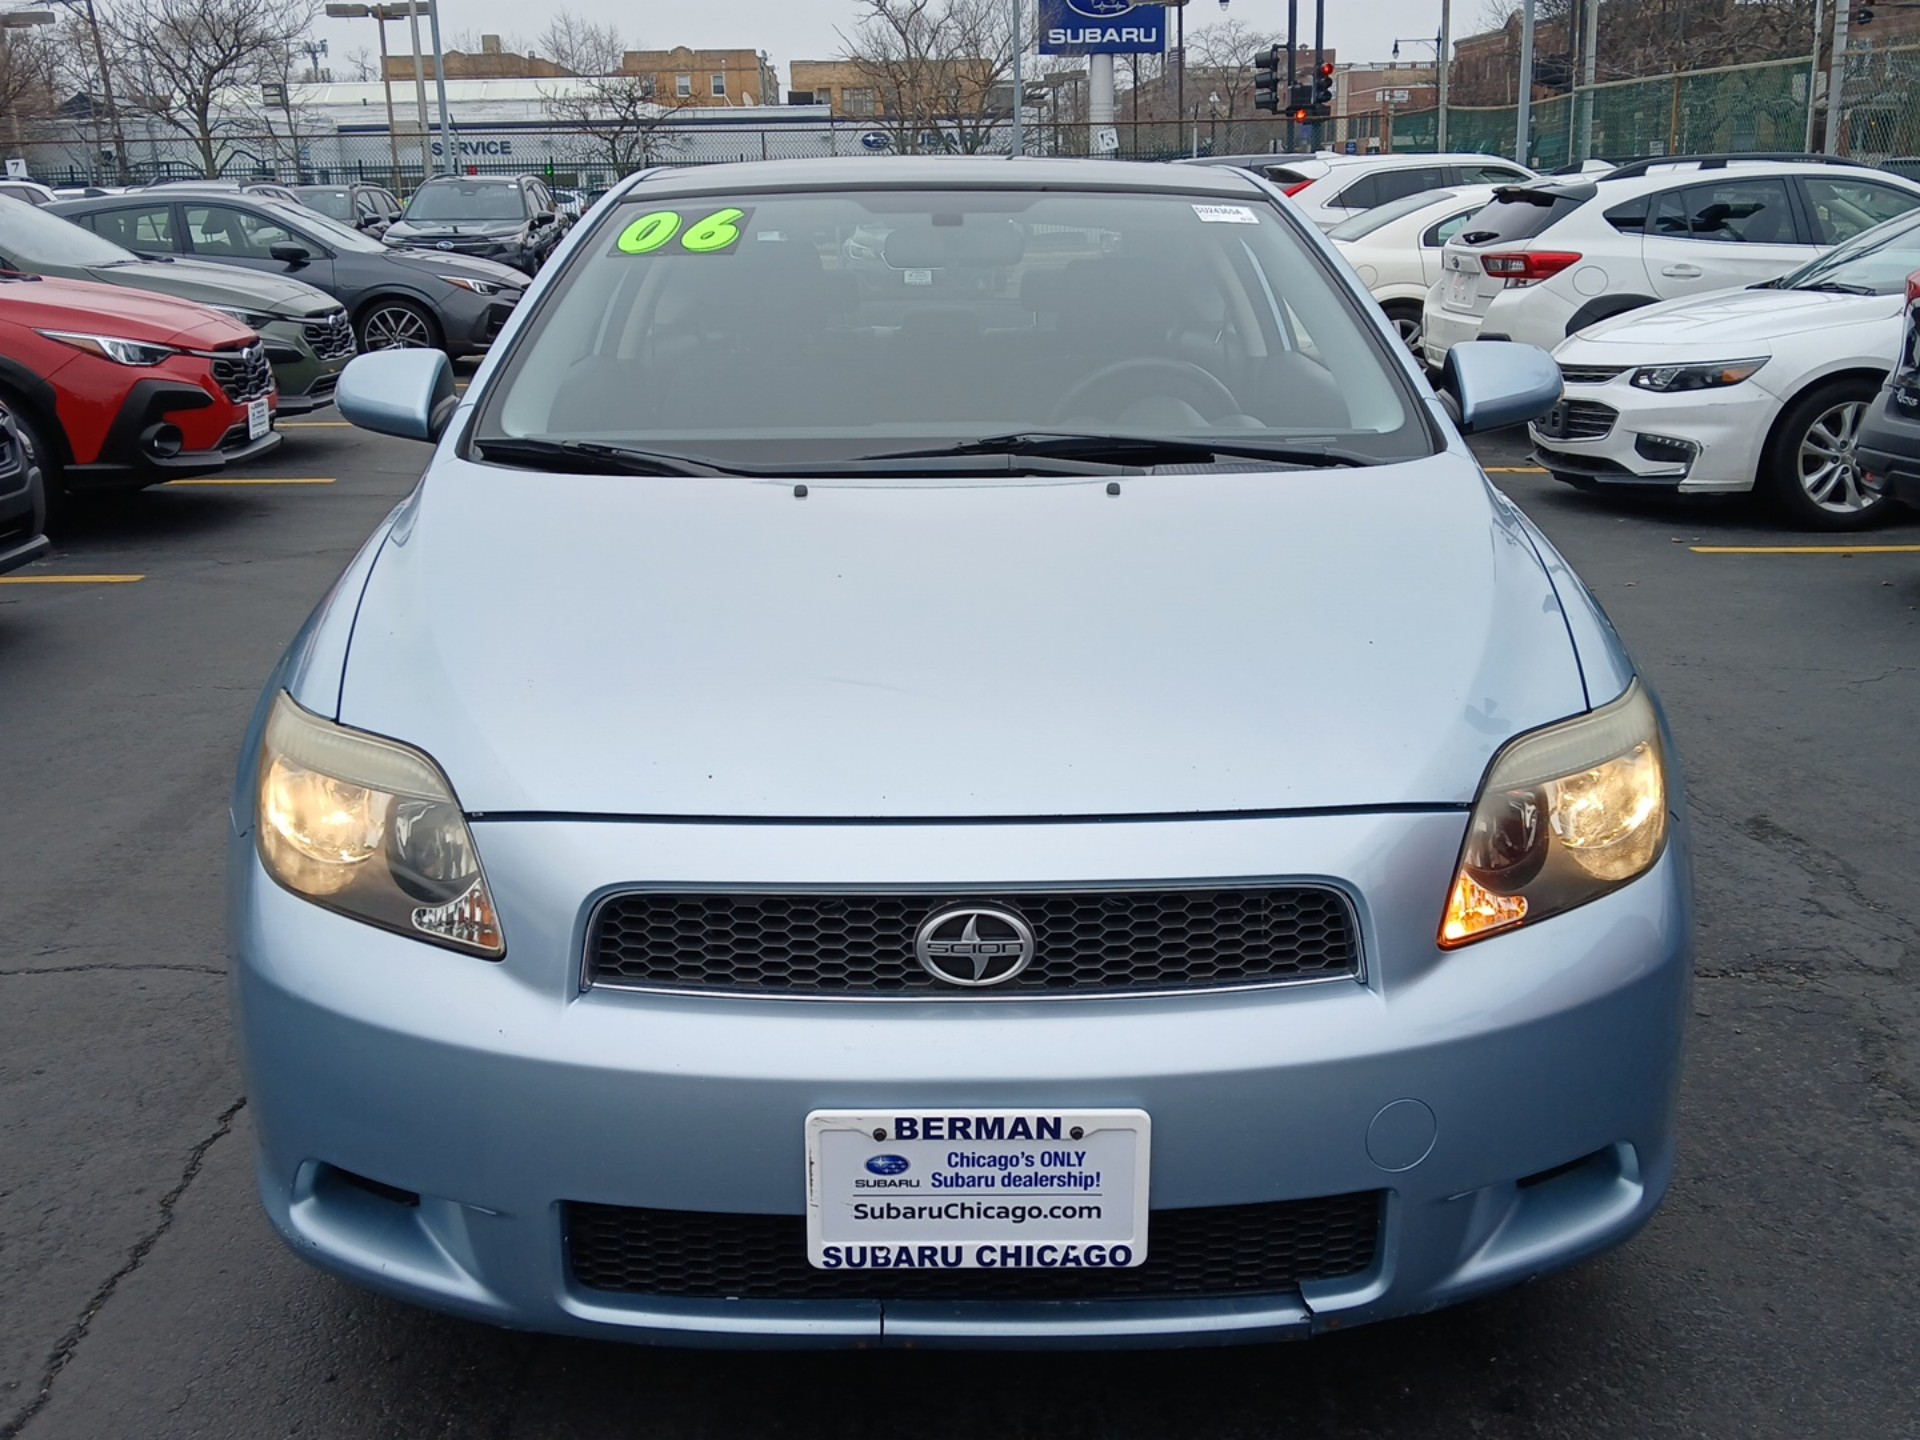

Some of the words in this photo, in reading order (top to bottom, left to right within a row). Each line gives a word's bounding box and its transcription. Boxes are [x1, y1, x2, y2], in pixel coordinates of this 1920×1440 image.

[1048, 27, 1157, 44] SUBARU
[902, 131, 991, 146] UBAR
[11, 162, 19, 174] 7
[616, 207, 746, 256] 06
[927, 943, 1023, 954] SCION
[894, 1116, 1062, 1140] BERMAN
[947, 1151, 1036, 1169] Chicago's
[1040, 1151, 1087, 1168] ONLY
[855, 1179, 921, 1188] SUBARU
[931, 1171, 996, 1188] Subaru
[1000, 1171, 1102, 1190] dealership!
[853, 1202, 1102, 1224] SubaruChicago.com
[822, 1245, 964, 1268] SUBARU
[975, 1245, 1134, 1268] CHICAGO
